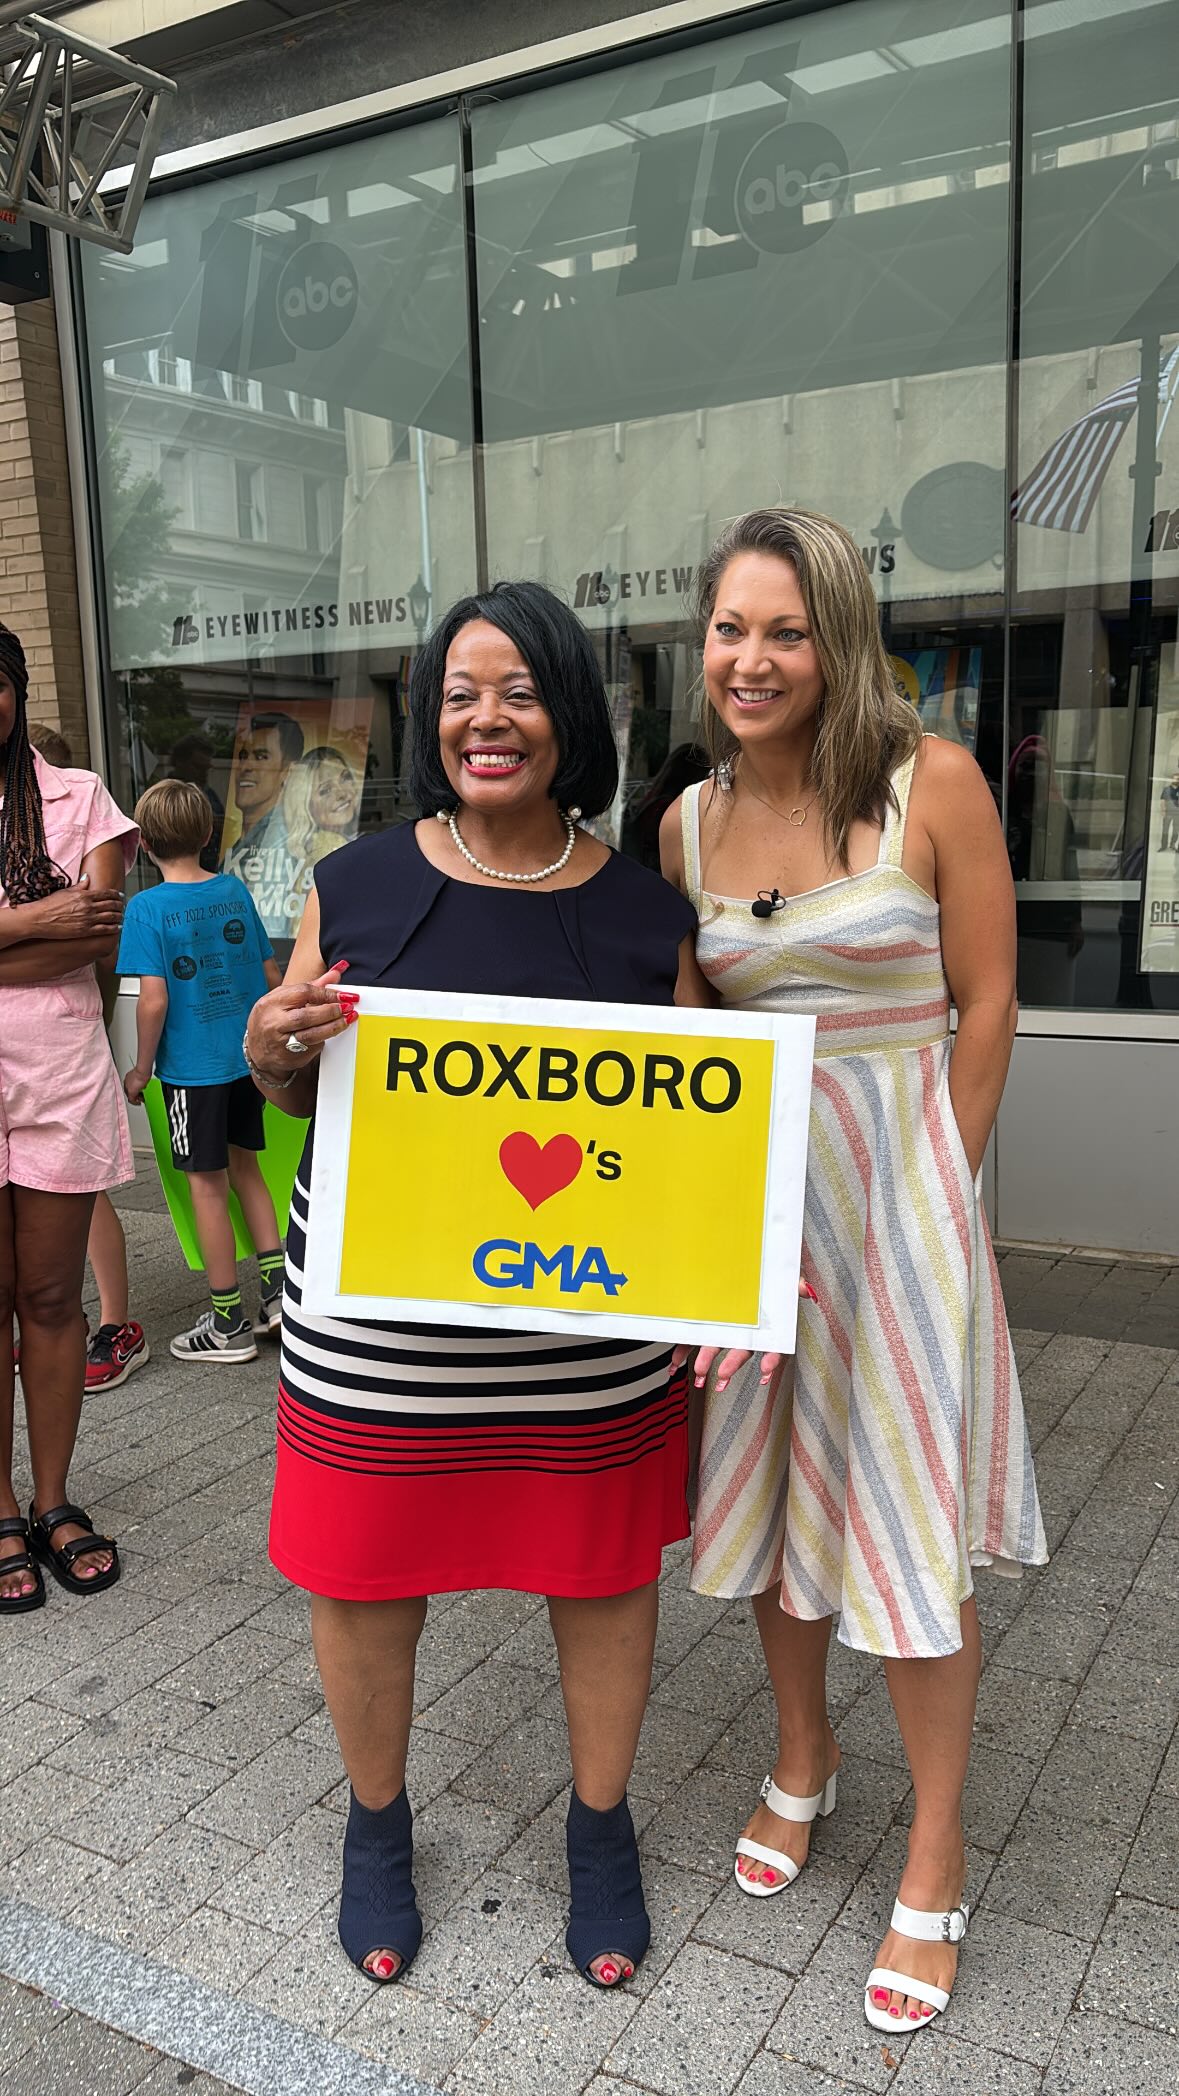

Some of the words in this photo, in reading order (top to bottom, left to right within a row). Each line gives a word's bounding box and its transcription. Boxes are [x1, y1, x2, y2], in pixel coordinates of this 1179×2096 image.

[743, 162, 842, 215] abc
[283, 275, 353, 318] abc
[205, 604, 339, 639] EYEWITNESS
[349, 597, 407, 627] NEWS
[223, 847, 306, 892] Kelly
[166, 913, 182, 929] FFF
[184, 906, 206, 923] 2022
[385, 1037, 743, 1114] ROXBORO
[472, 1238, 629, 1296] GMA
